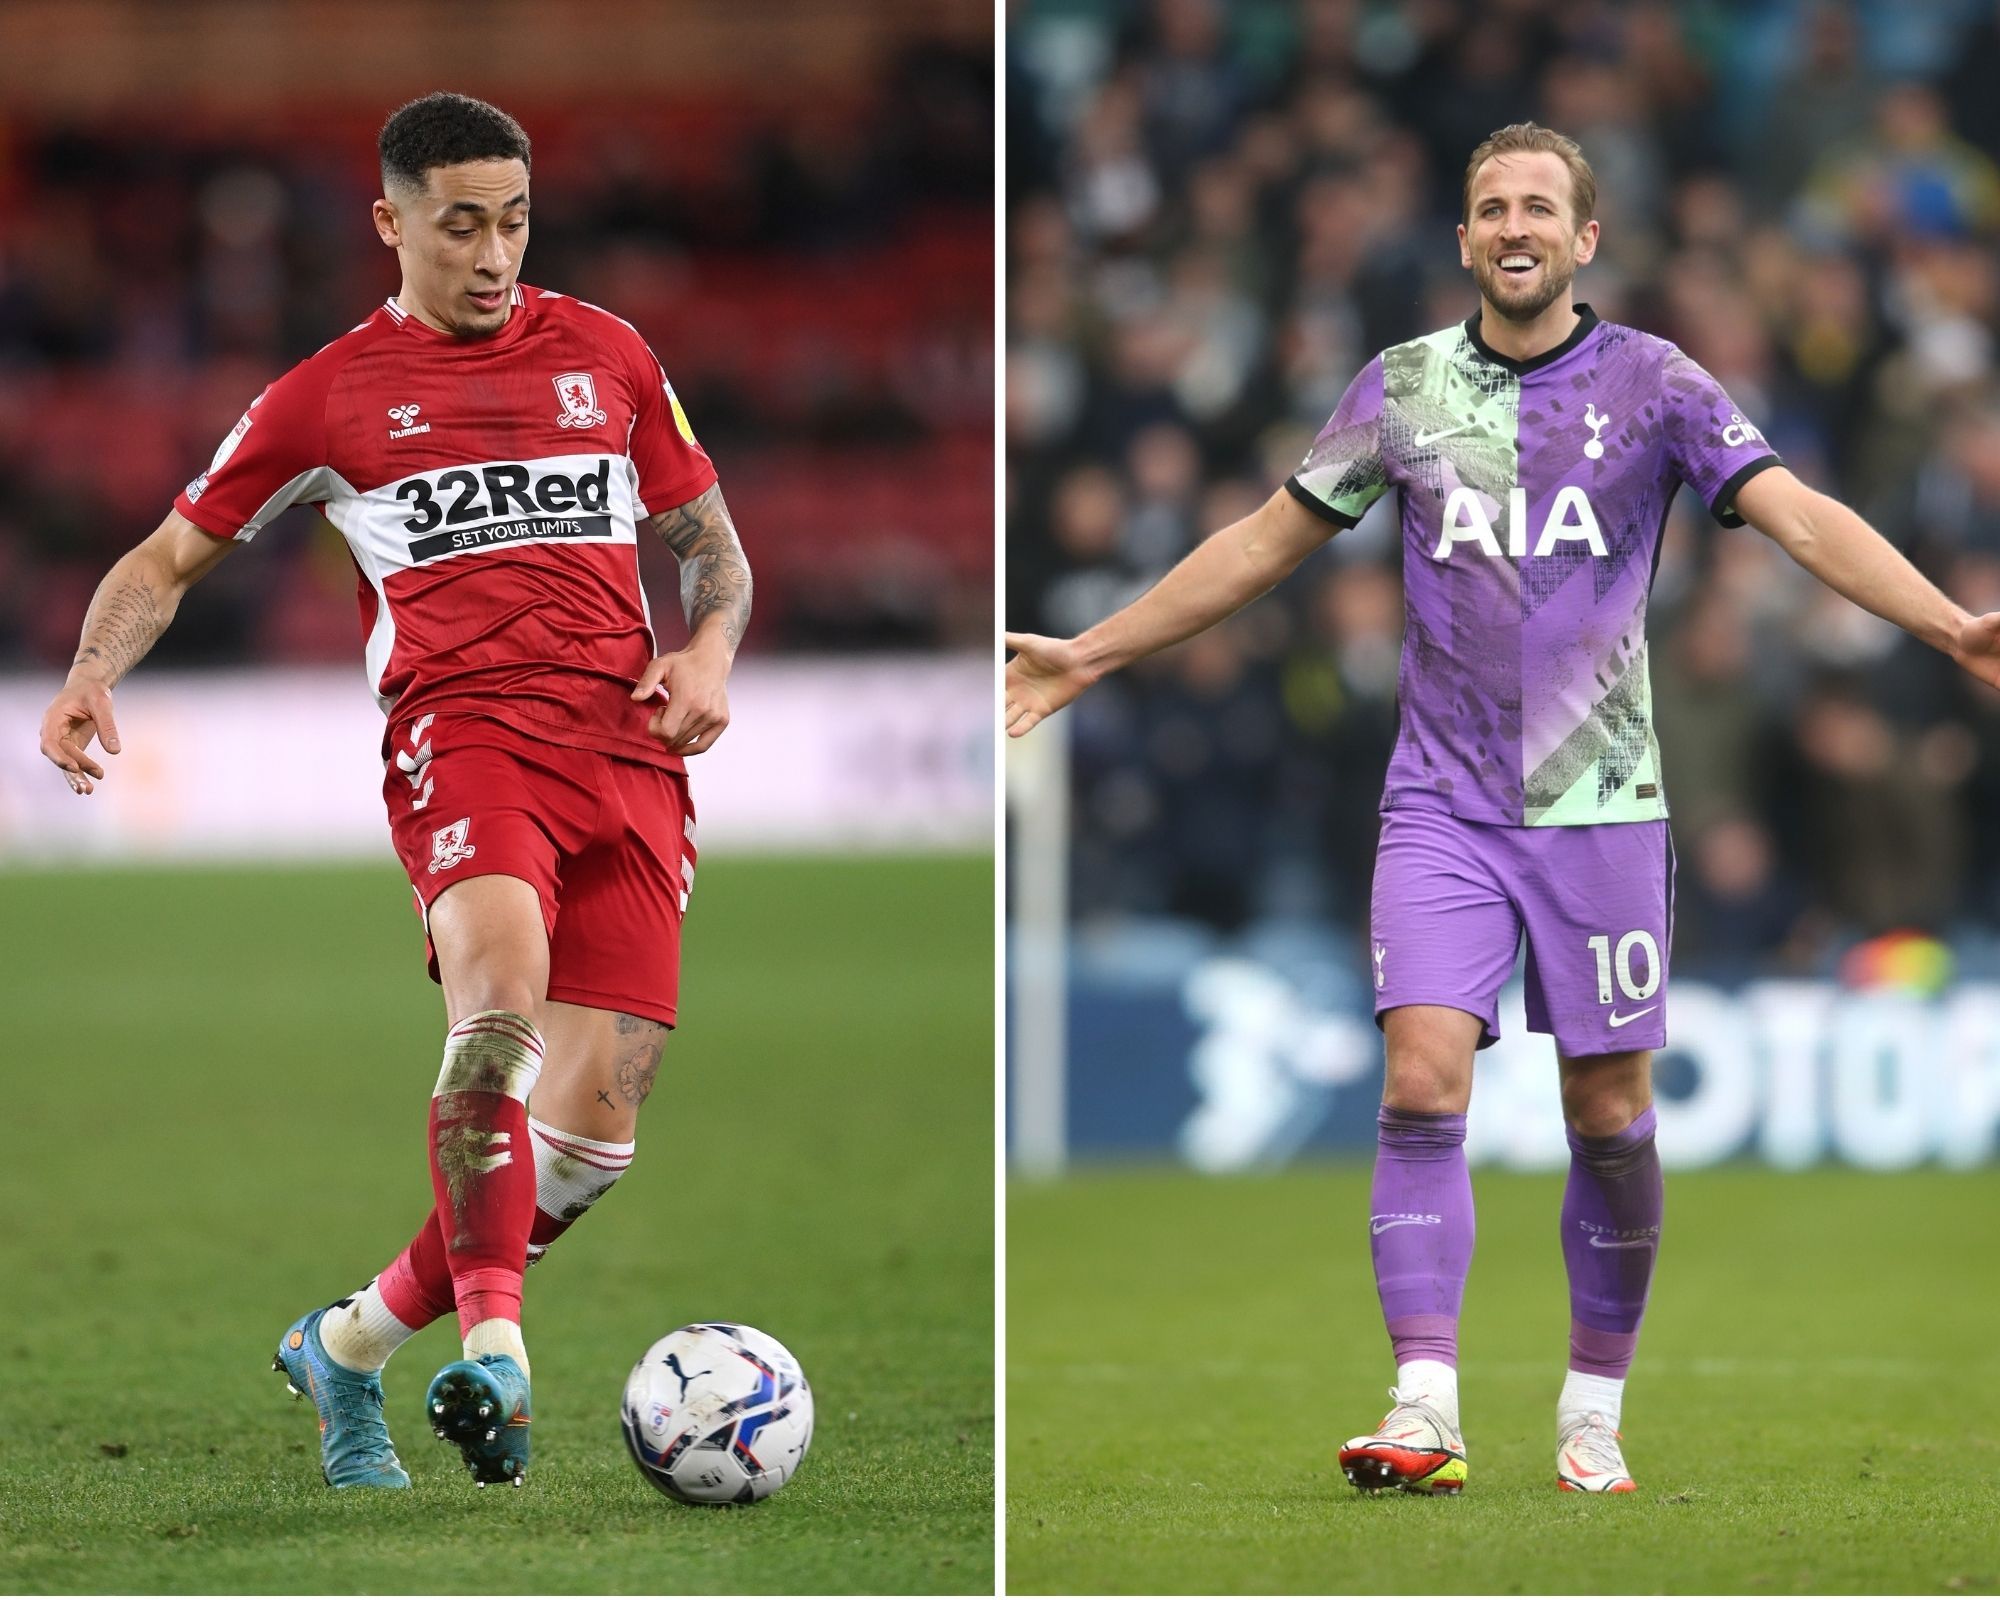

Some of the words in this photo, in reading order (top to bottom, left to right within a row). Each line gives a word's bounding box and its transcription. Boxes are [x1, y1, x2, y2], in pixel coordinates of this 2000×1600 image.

[390, 422, 430, 440] hummel
[396, 459, 611, 534] 32Red
[1432, 486, 1609, 559] AIA
[451, 529, 481, 548] SET
[482, 522, 530, 542] YOUR
[532, 520, 583, 536] LIMITS
[1587, 929, 1662, 1005] 10
